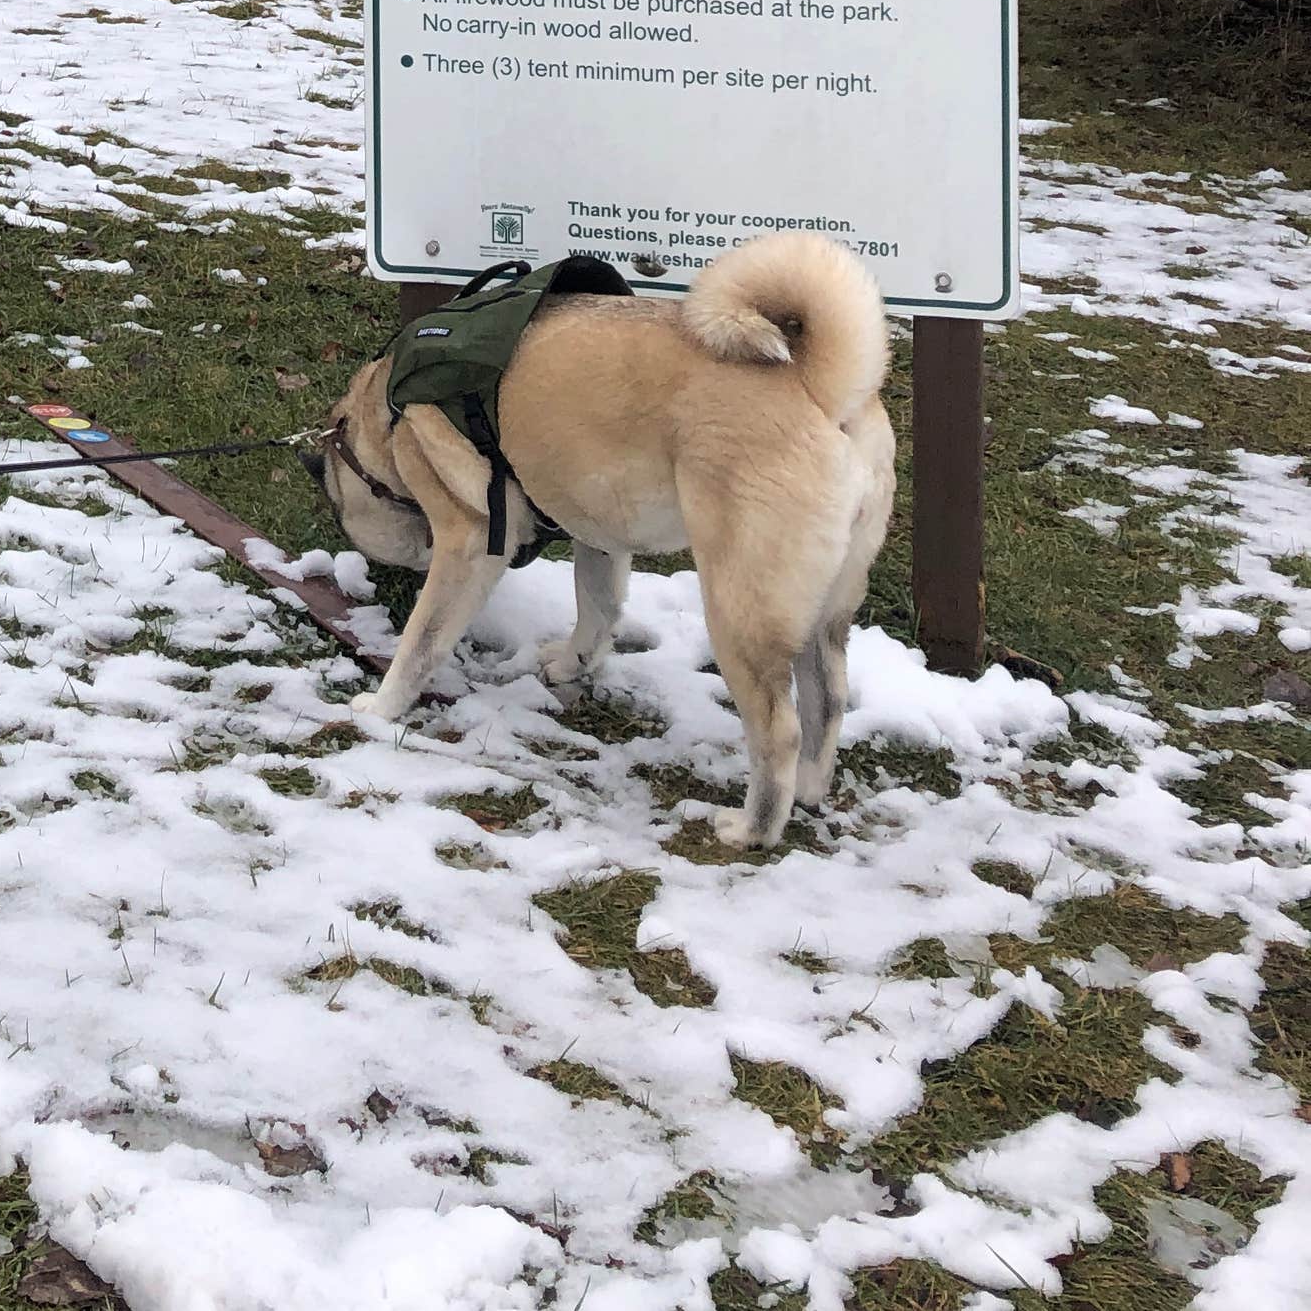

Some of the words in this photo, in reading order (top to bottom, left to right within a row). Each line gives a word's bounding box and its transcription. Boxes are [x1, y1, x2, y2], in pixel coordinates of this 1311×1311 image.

[423, 12, 452, 33] No
[456, 16, 536, 40] carry-in
[543, 20, 601, 39] wood
[608, 21, 698, 43] allowed.
[771, 0, 793, 18] at
[799, 0, 835, 19] the
[843, 1, 898, 25] park.
[422, 53, 485, 75] Three
[492, 56, 521, 82] (3)
[527, 59, 569, 79] tent
[576, 61, 675, 83] minimum
[682, 69, 719, 89] per
[725, 67, 764, 88] site
[772, 74, 809, 93] per
[816, 72, 877, 97] night.
[567, 200, 622, 219] Thank
[626, 208, 660, 223] you
[664, 206, 691, 223] for
[695, 212, 737, 228] your
[741, 215, 856, 233] cooperation.
[567, 222, 663, 244] Questions,
[668, 231, 727, 249] please
